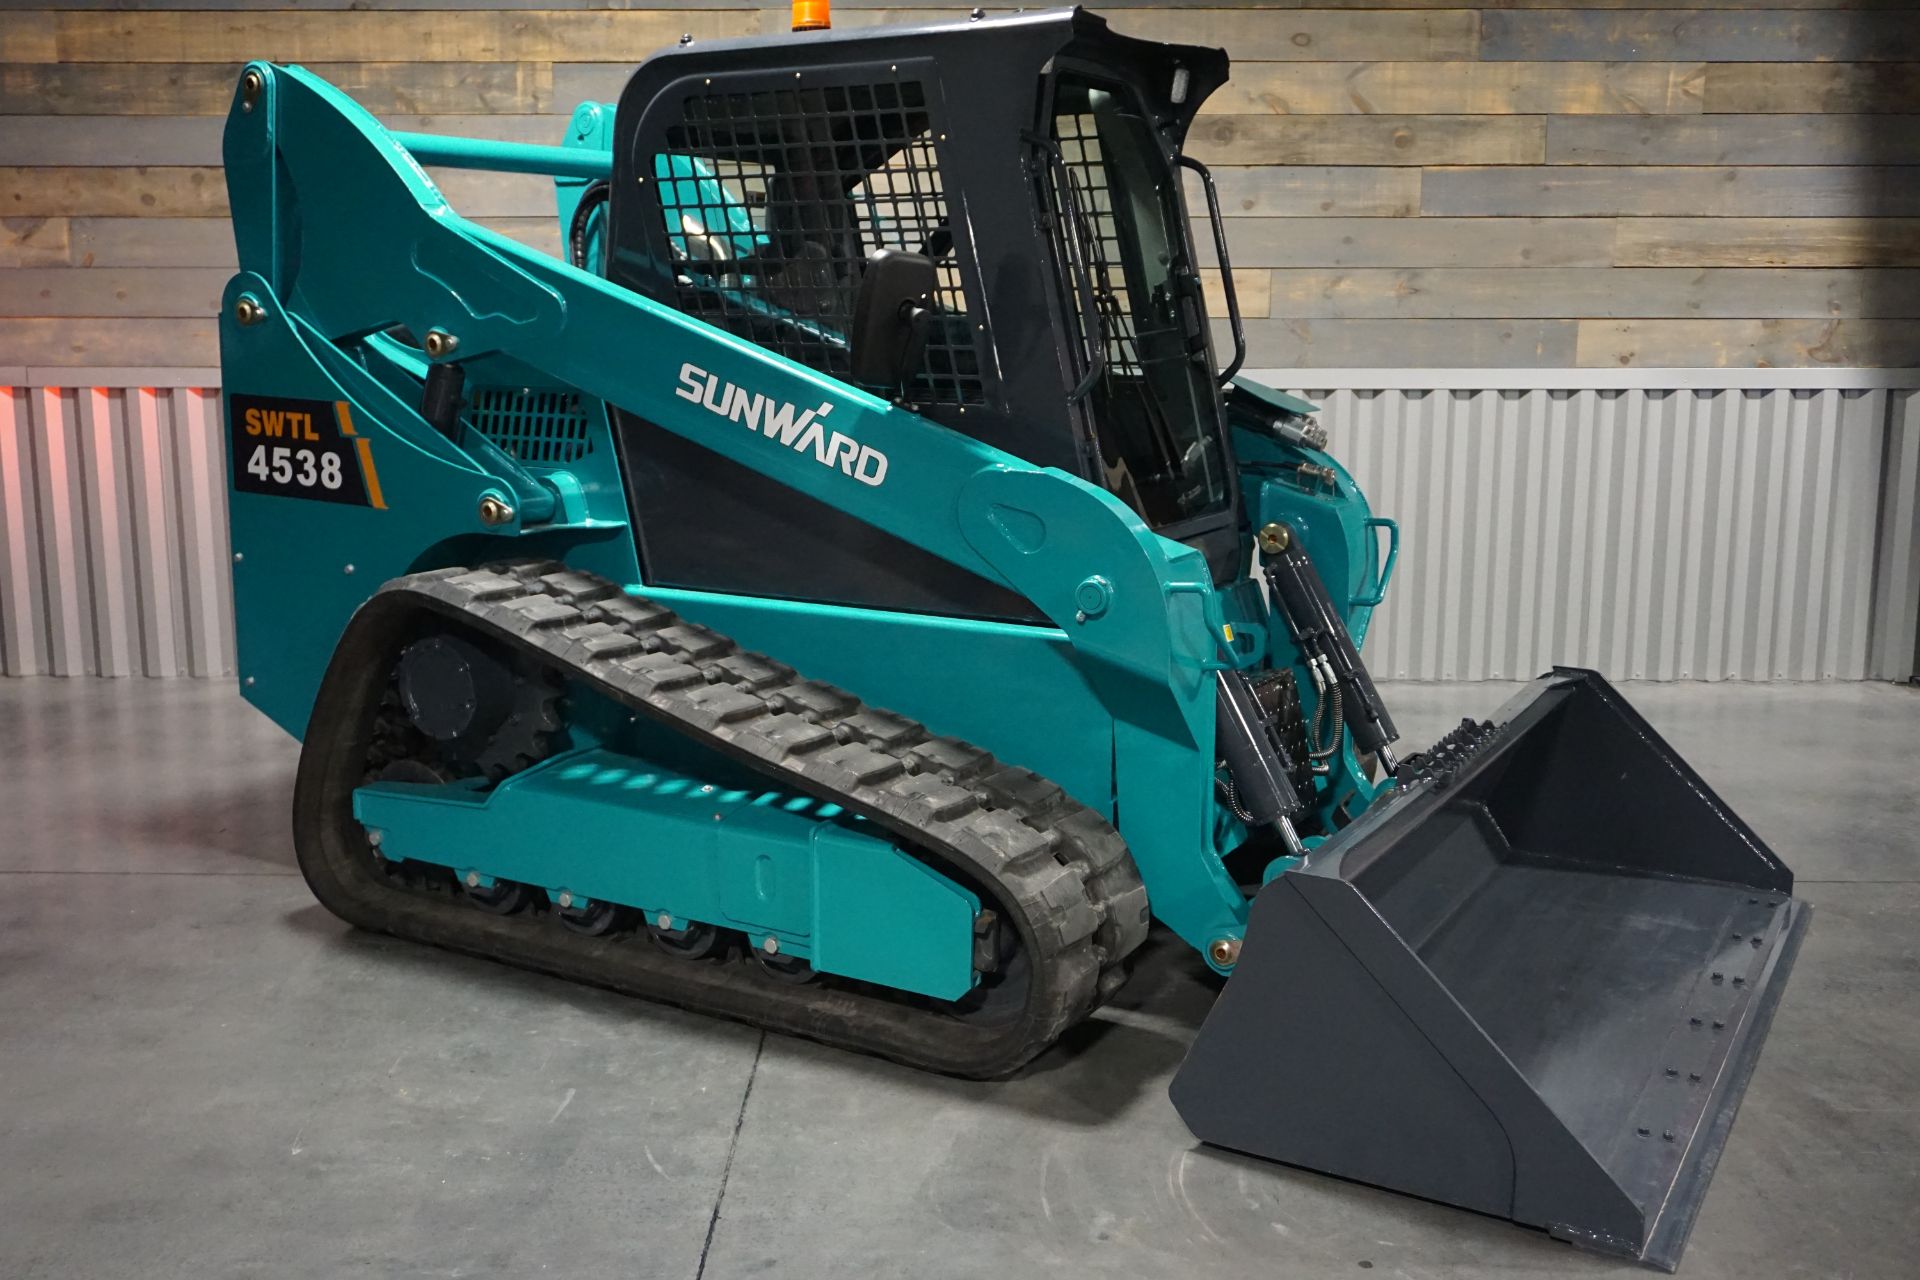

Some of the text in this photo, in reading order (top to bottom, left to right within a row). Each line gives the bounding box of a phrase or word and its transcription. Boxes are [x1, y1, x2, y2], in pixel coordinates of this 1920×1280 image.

[245, 408, 319, 441] SWTL
[675, 362, 889, 487] SUNWARD
[247, 444, 343, 490] 4538
